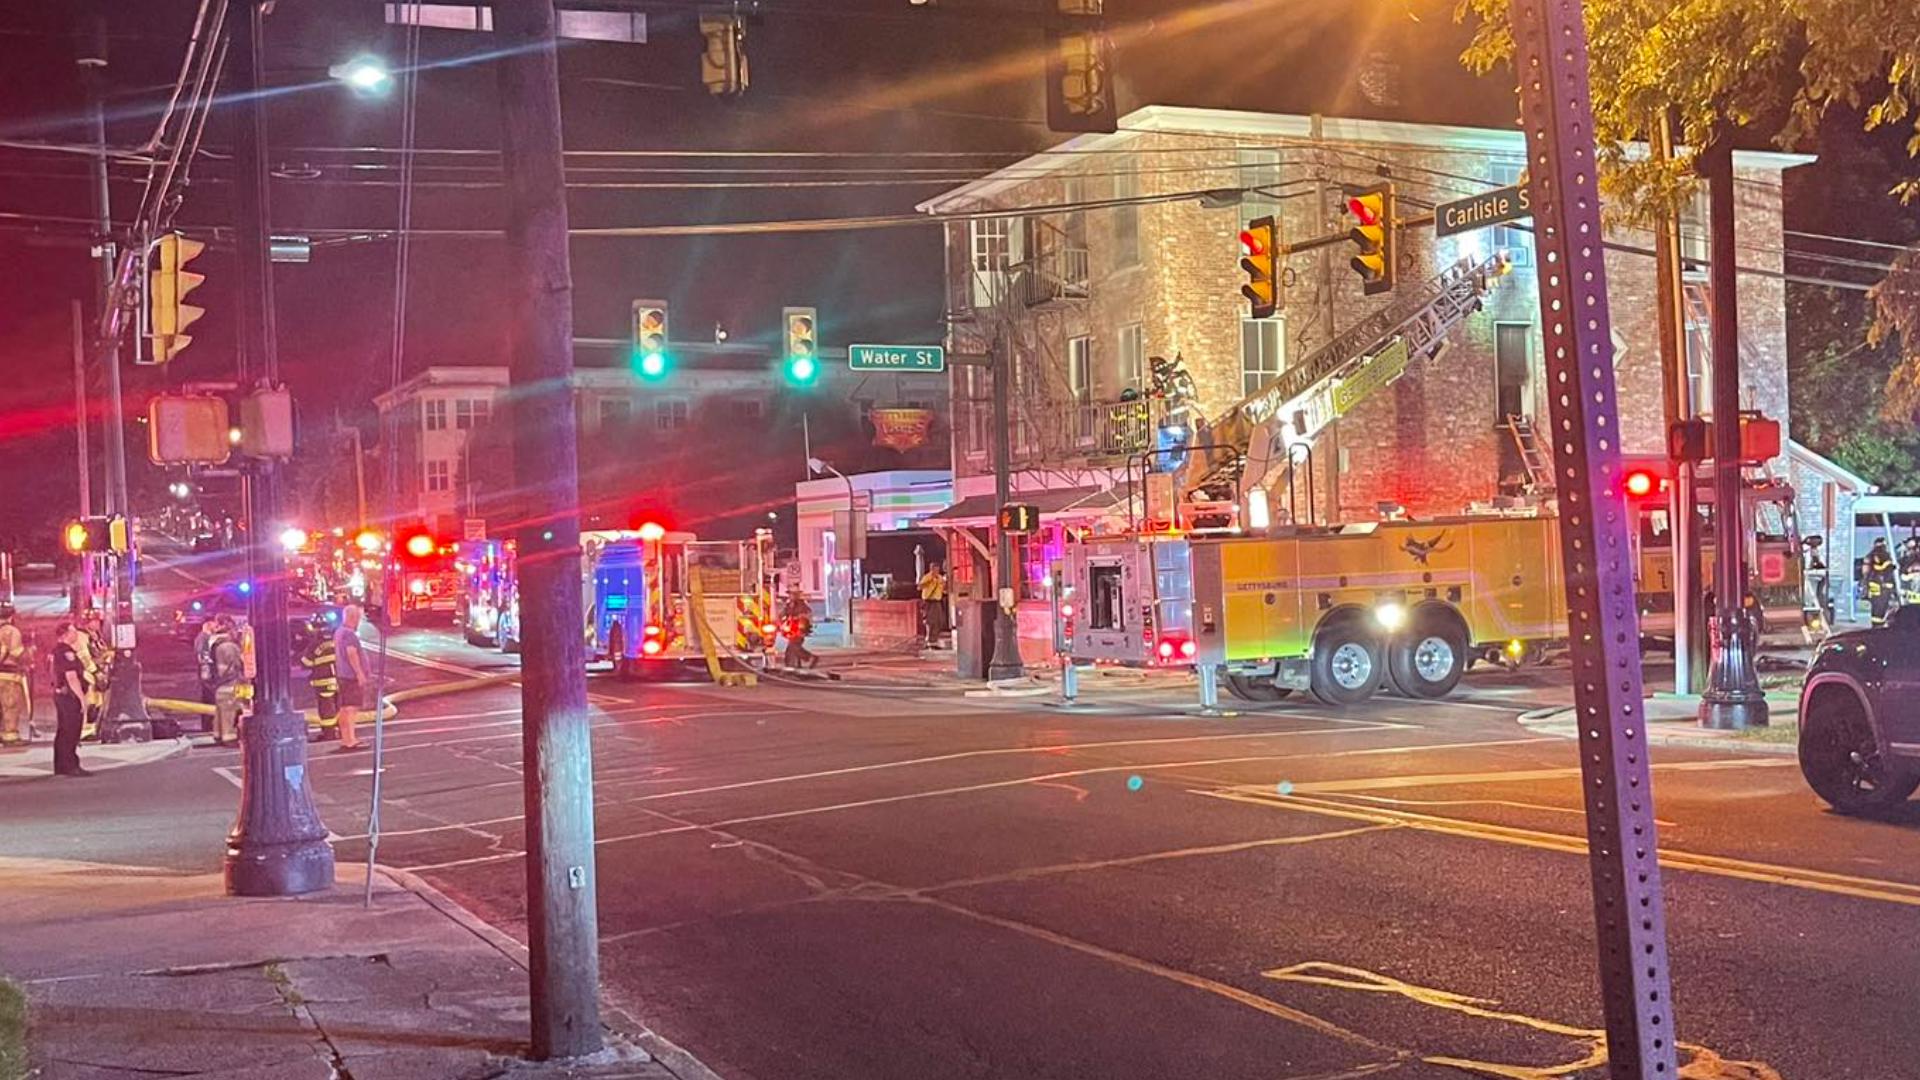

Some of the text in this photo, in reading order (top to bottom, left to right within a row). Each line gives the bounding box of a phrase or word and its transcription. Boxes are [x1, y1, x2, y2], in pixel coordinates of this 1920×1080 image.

[1446, 189, 1531, 228] Carlisle S
[860, 350, 933, 365] Water St
